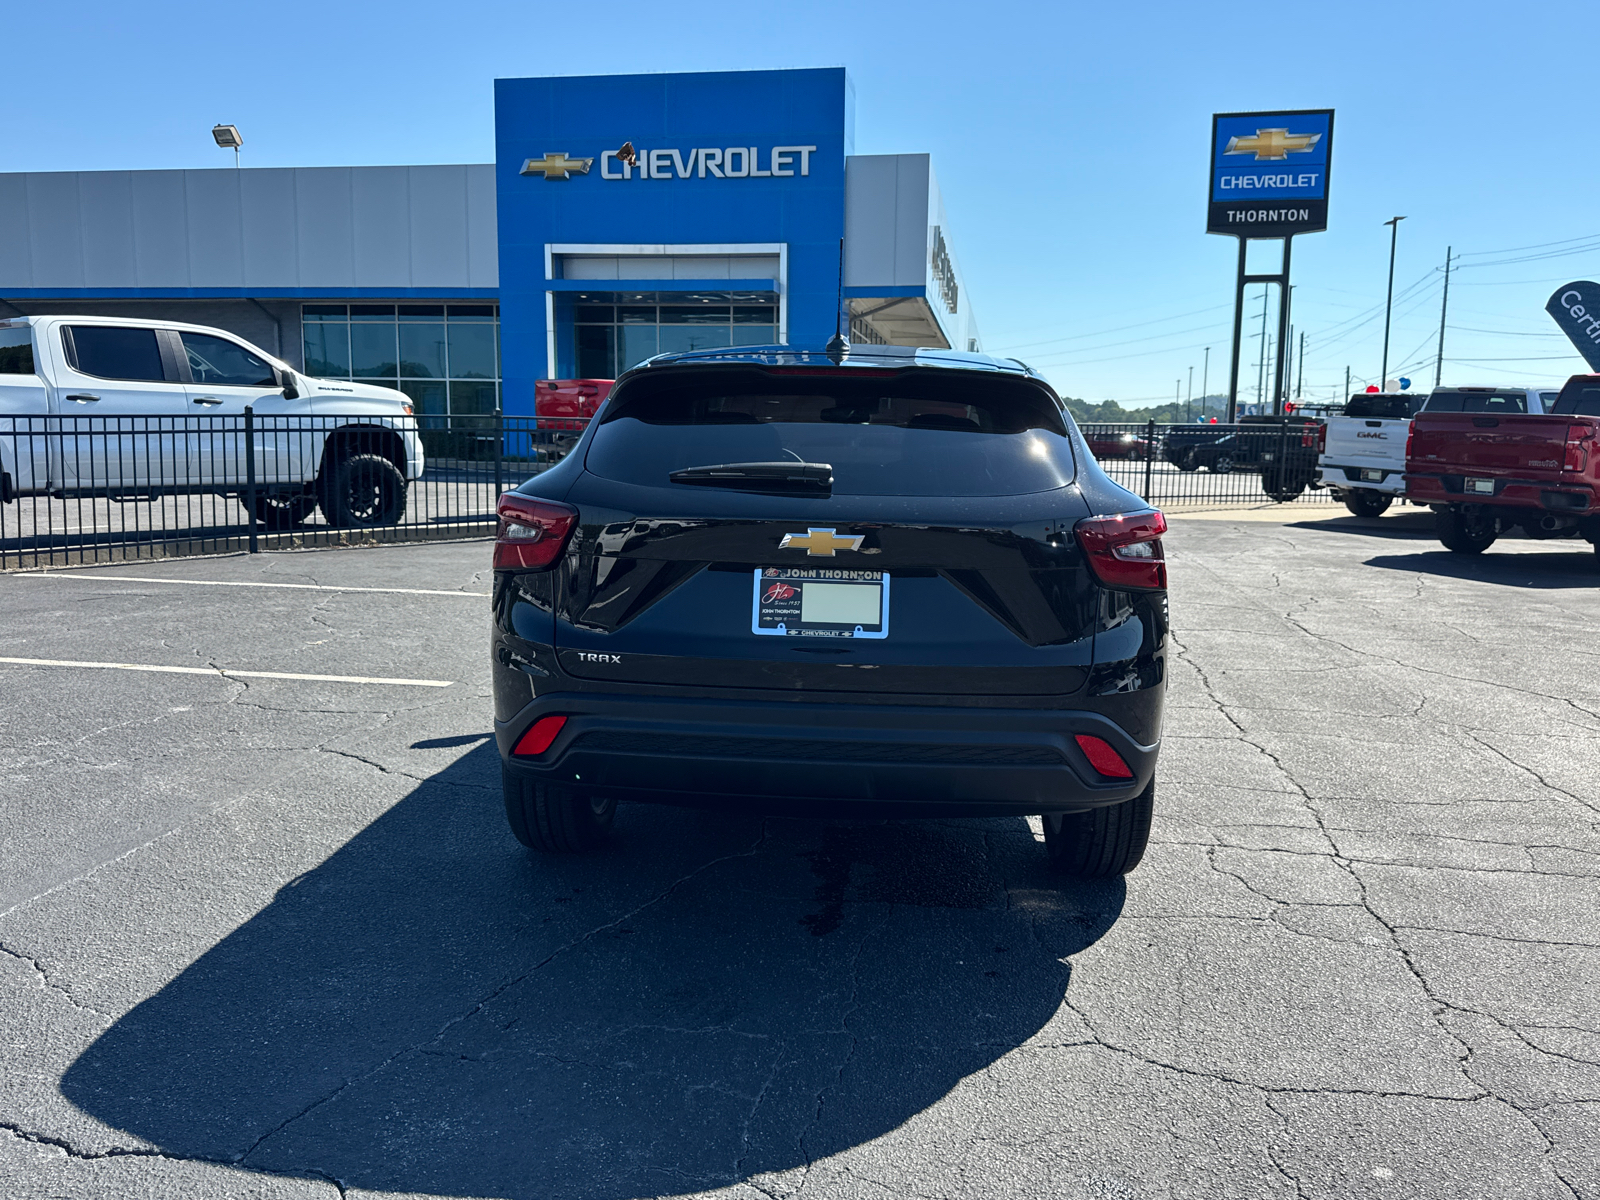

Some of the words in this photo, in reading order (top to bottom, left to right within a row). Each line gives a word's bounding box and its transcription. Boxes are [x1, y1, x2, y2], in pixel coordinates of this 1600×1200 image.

[601, 145, 817, 180] CHEVROLET
[1220, 174, 1319, 188] CHEVROLET
[1227, 209, 1309, 222] THORNTON
[1560, 290, 1600, 344] Certi
[1356, 431, 1388, 440] GMC
[785, 569, 817, 578] JOHN
[819, 570, 882, 580] THORNTON
[578, 652, 621, 664] TRAX
